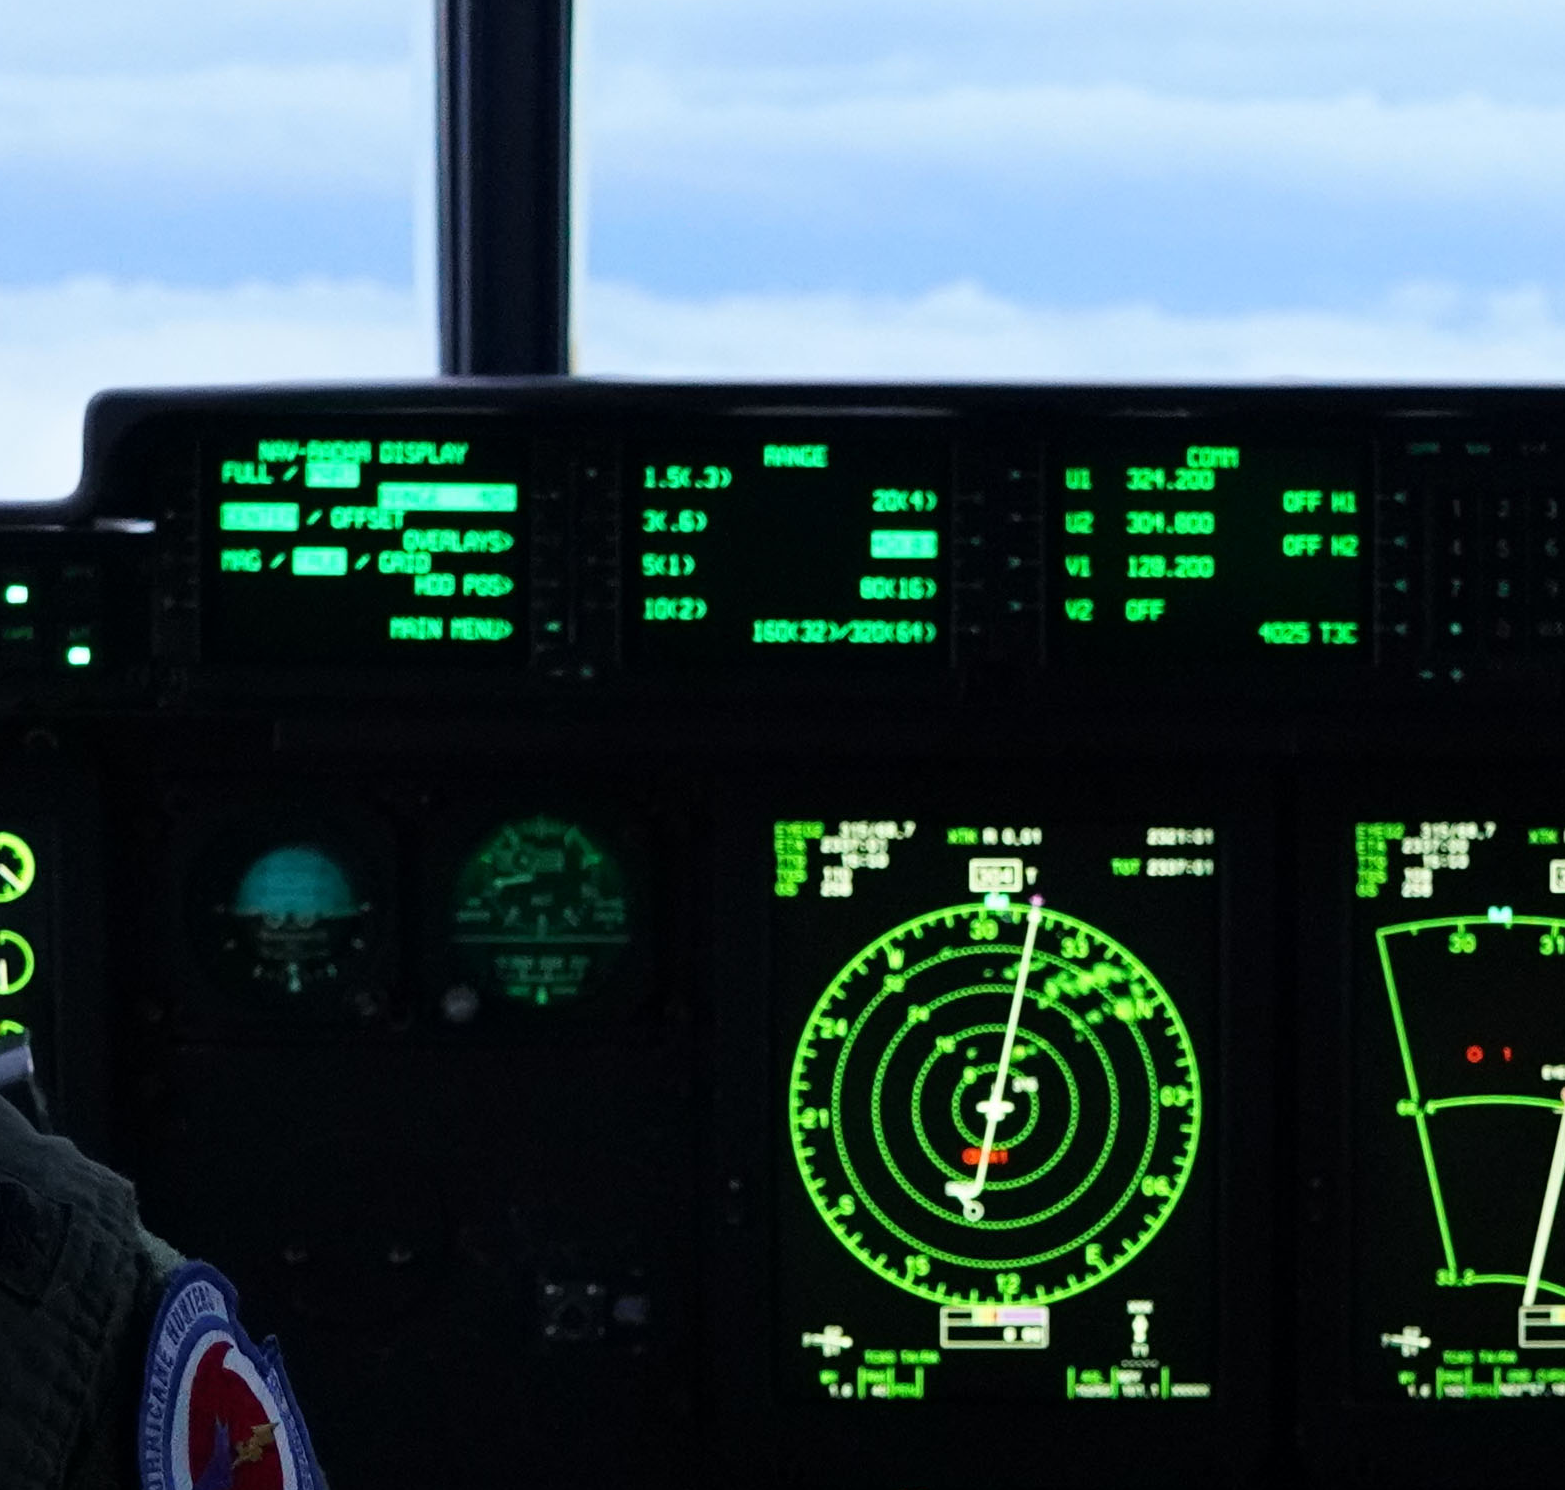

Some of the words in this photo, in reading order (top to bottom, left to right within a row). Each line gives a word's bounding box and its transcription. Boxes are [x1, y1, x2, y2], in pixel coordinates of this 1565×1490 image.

[379, 442, 468, 464] DISPLAY
[764, 445, 827, 467] RANGE
[1186, 446, 1239, 468] COMM
[221, 462, 276, 484] FULL
[1065, 468, 1092, 490] U1
[1283, 490, 1322, 513] OFF
[330, 509, 405, 531] OFFSET
[1066, 511, 1094, 534] U2
[1283, 534, 1322, 557] OFF
[642, 553, 695, 576] 5(1)
[1065, 556, 1091, 577] V1
[644, 597, 707, 620] 10(2)
[1065, 599, 1093, 621] V2
[1125, 599, 1165, 621] OFF
